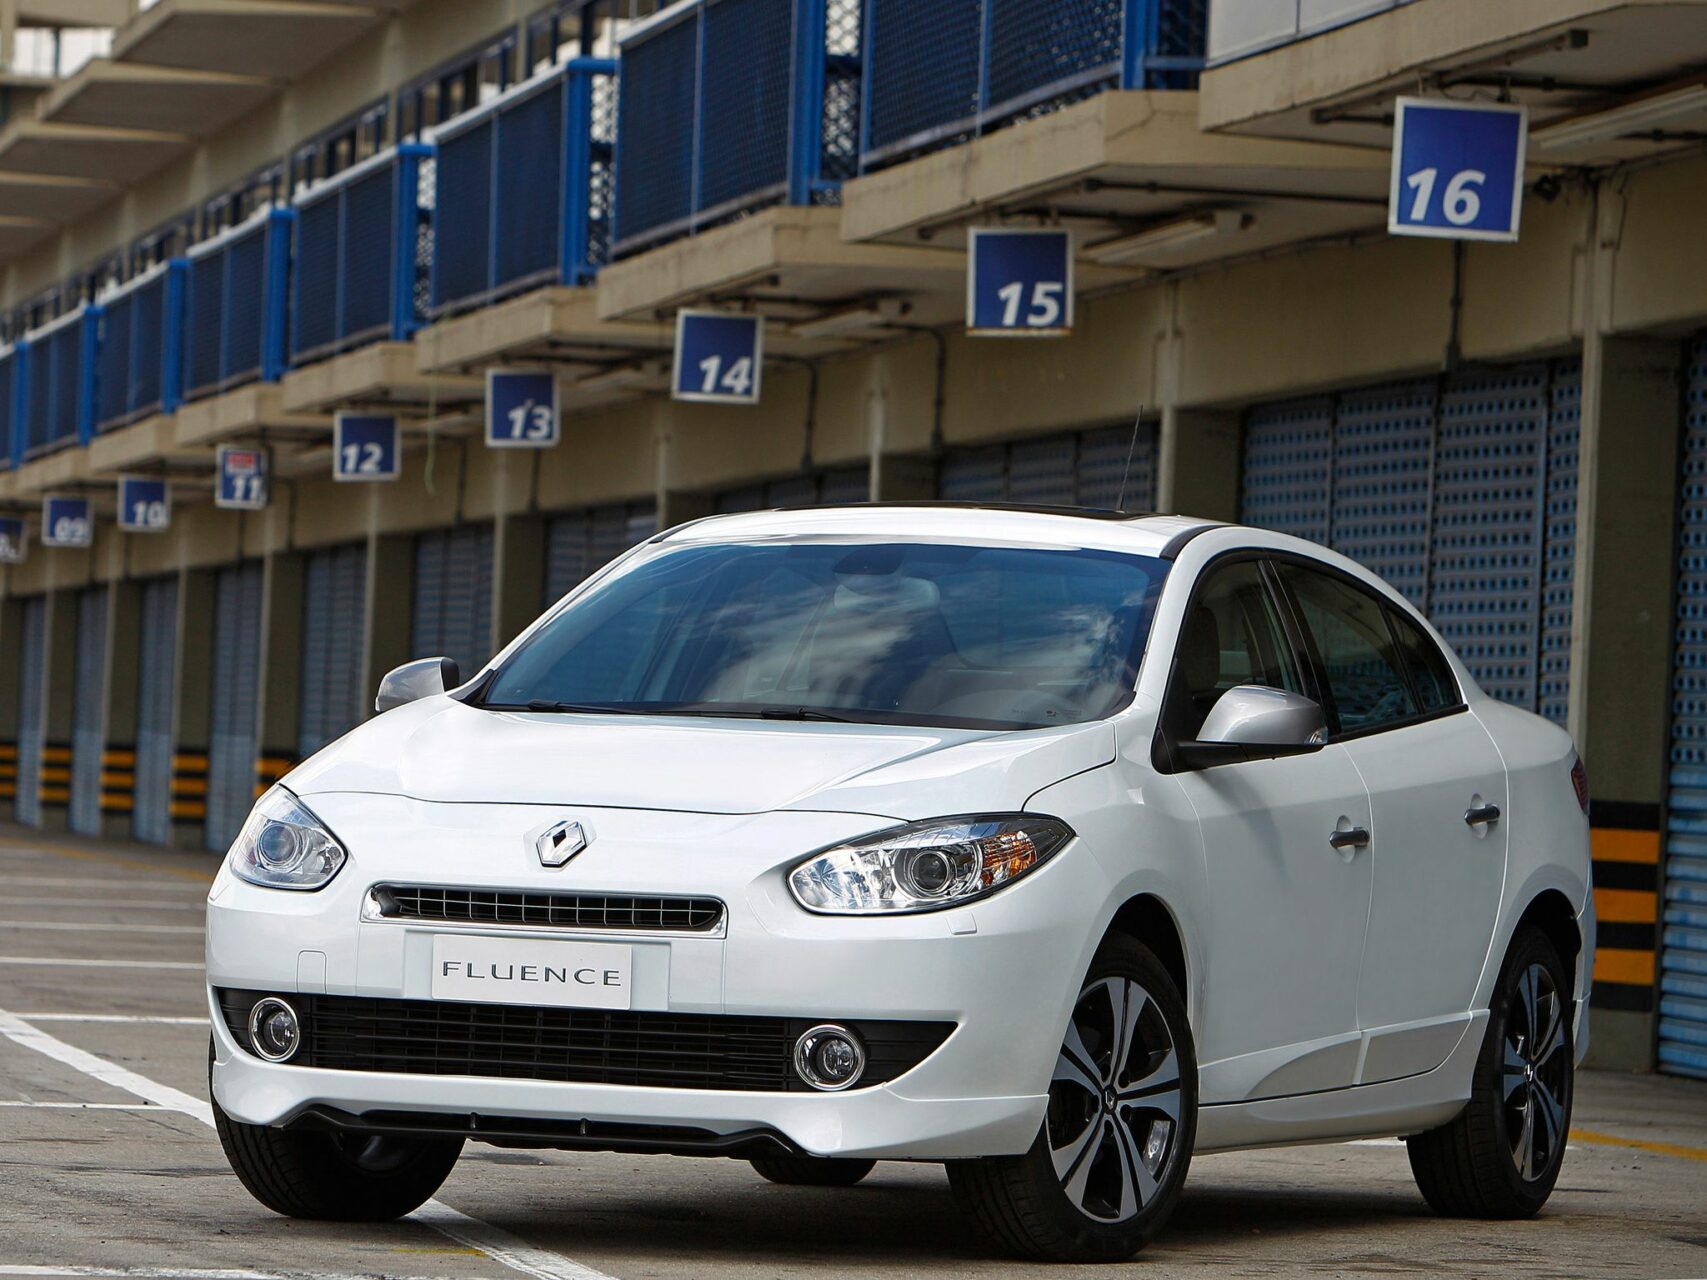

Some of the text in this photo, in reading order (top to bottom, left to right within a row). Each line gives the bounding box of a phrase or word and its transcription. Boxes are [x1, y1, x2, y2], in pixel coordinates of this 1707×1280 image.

[1406, 168, 1486, 225] 16
[998, 282, 1064, 327] 15
[700, 356, 752, 394] 14
[508, 404, 553, 439] 13
[342, 443, 382, 473] 12
[231, 476, 263, 501] 11
[133, 502, 166, 526] 10
[442, 961, 622, 987] FLUENCE
